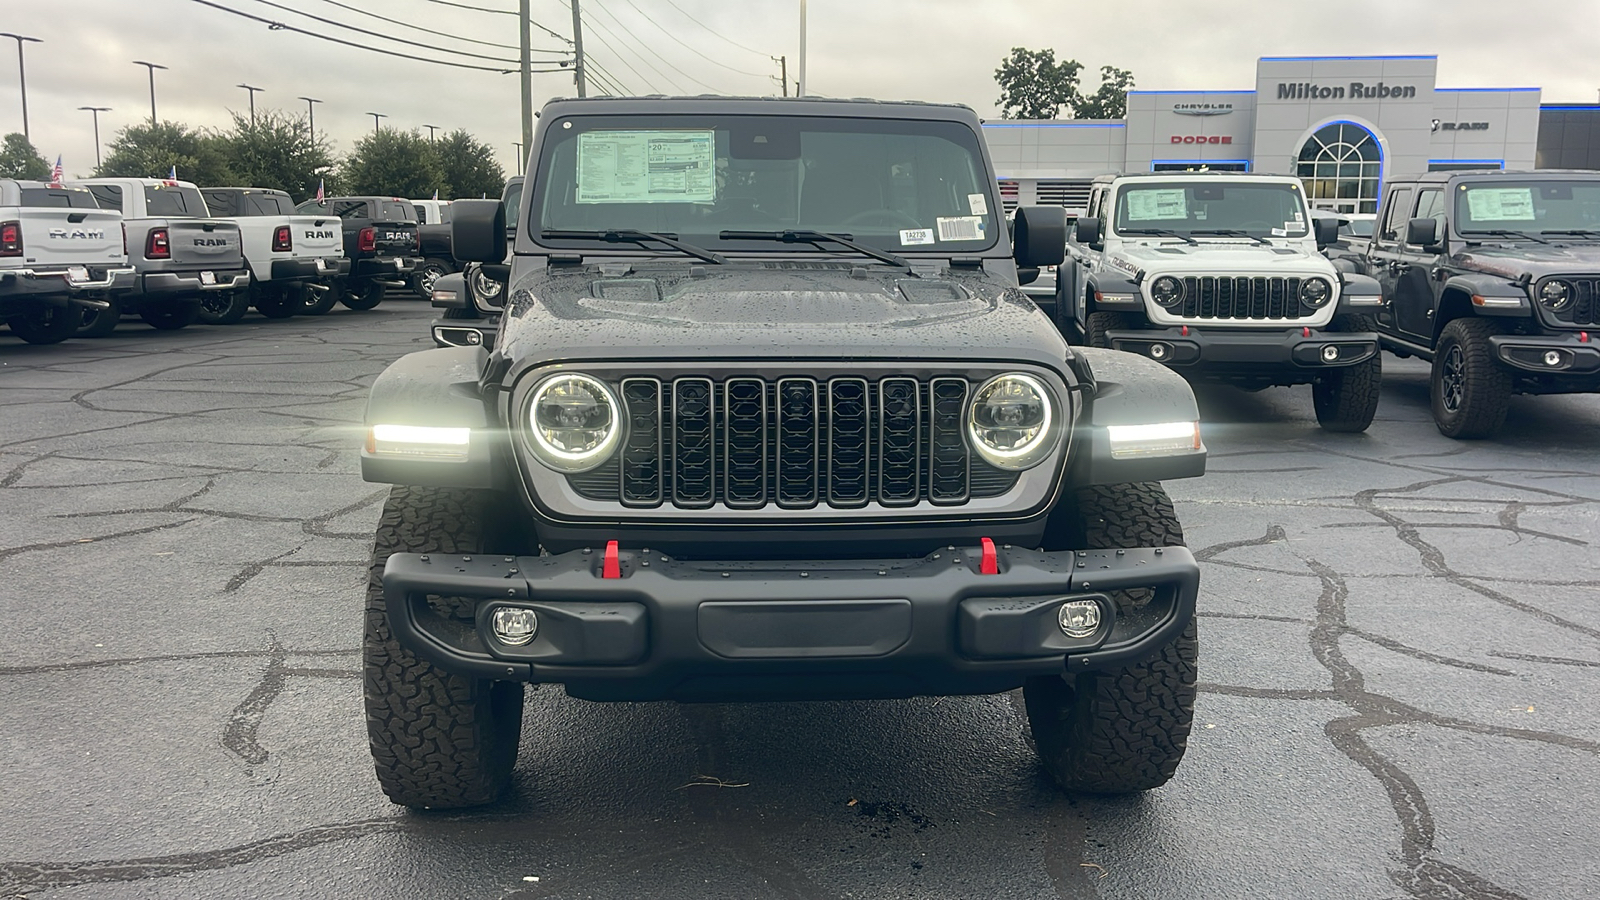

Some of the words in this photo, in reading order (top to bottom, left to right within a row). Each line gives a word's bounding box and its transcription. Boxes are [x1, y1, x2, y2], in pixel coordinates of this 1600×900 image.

[1277, 82, 1345, 99] Milton
[1349, 82, 1416, 99] Ruben
[1442, 122, 1489, 131] RAM
[1171, 136, 1233, 144] DODGE
[48, 227, 104, 239] RAM
[305, 231, 334, 239] RAM
[386, 232, 411, 240] RAM
[193, 238, 227, 246] RAM
[1112, 256, 1140, 274] RUBICON
